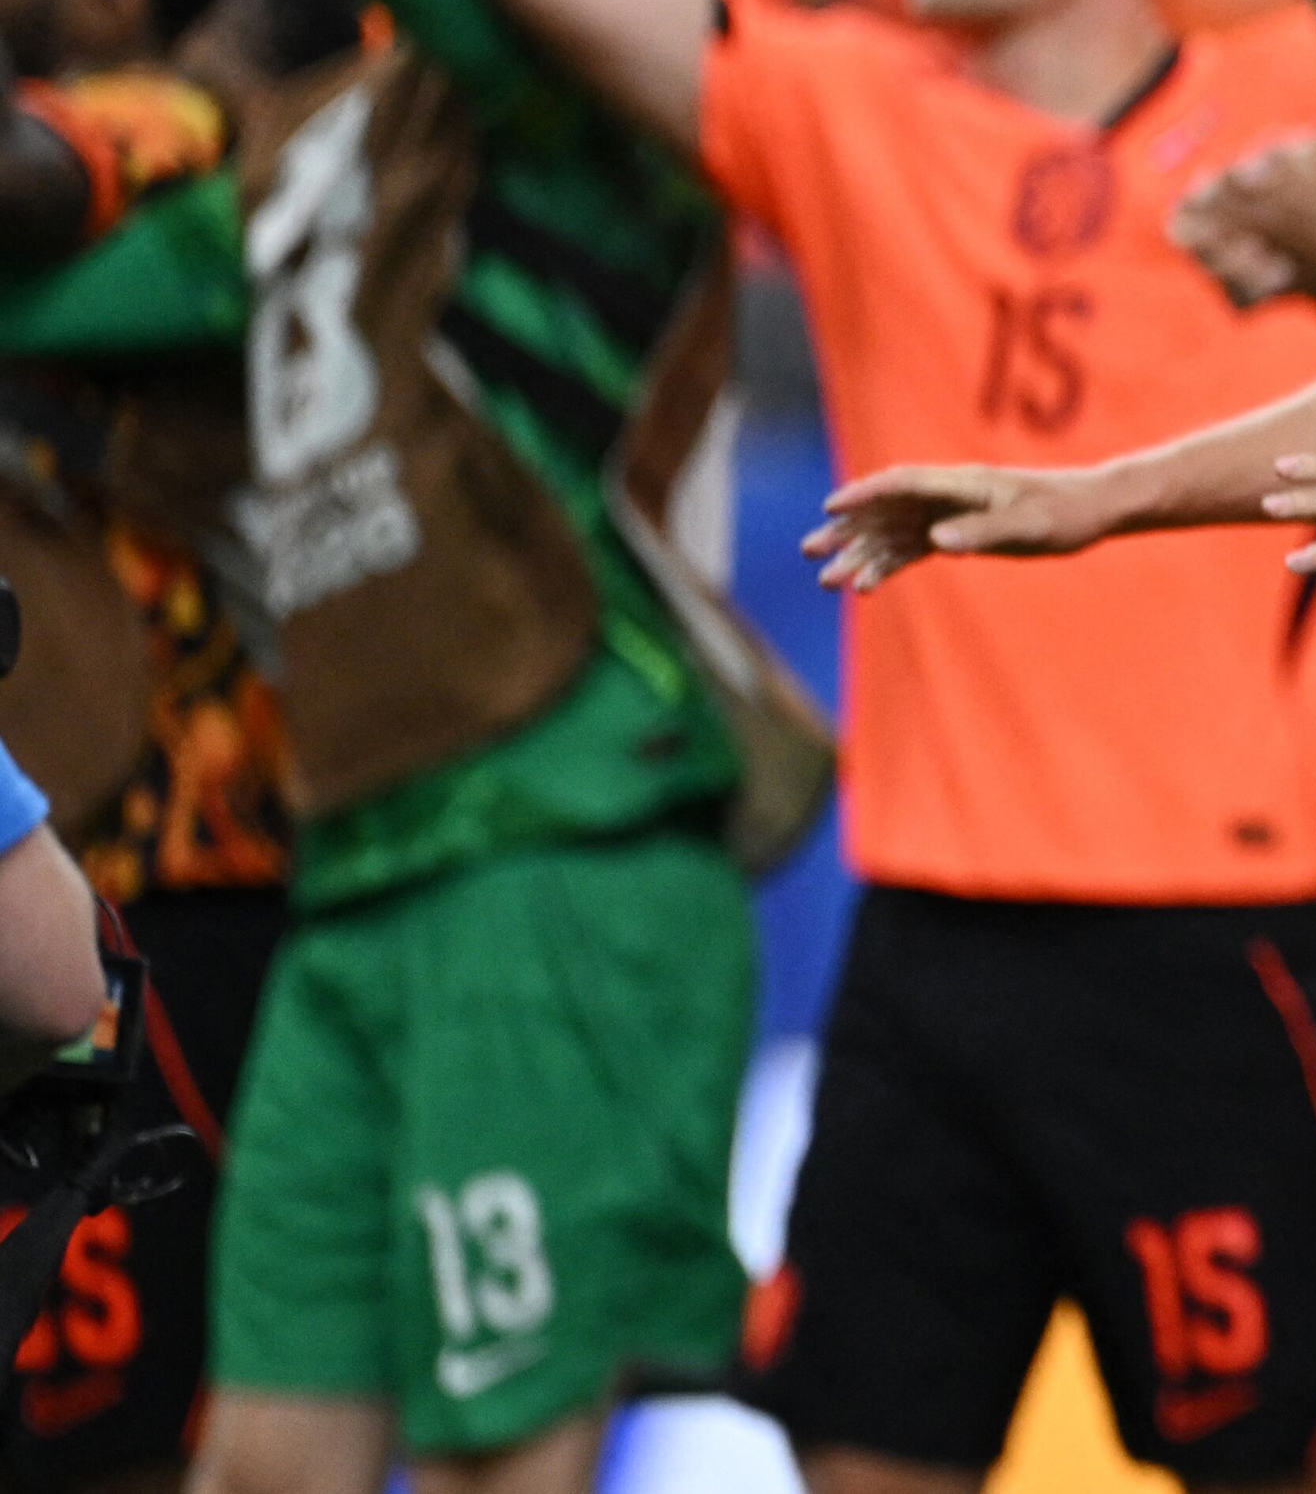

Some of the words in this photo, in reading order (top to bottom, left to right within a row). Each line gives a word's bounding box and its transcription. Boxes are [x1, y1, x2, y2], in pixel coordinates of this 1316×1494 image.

[977, 280, 1096, 436] 15
[414, 1170, 556, 1340] 13
[1125, 1207, 1267, 1379] 15
